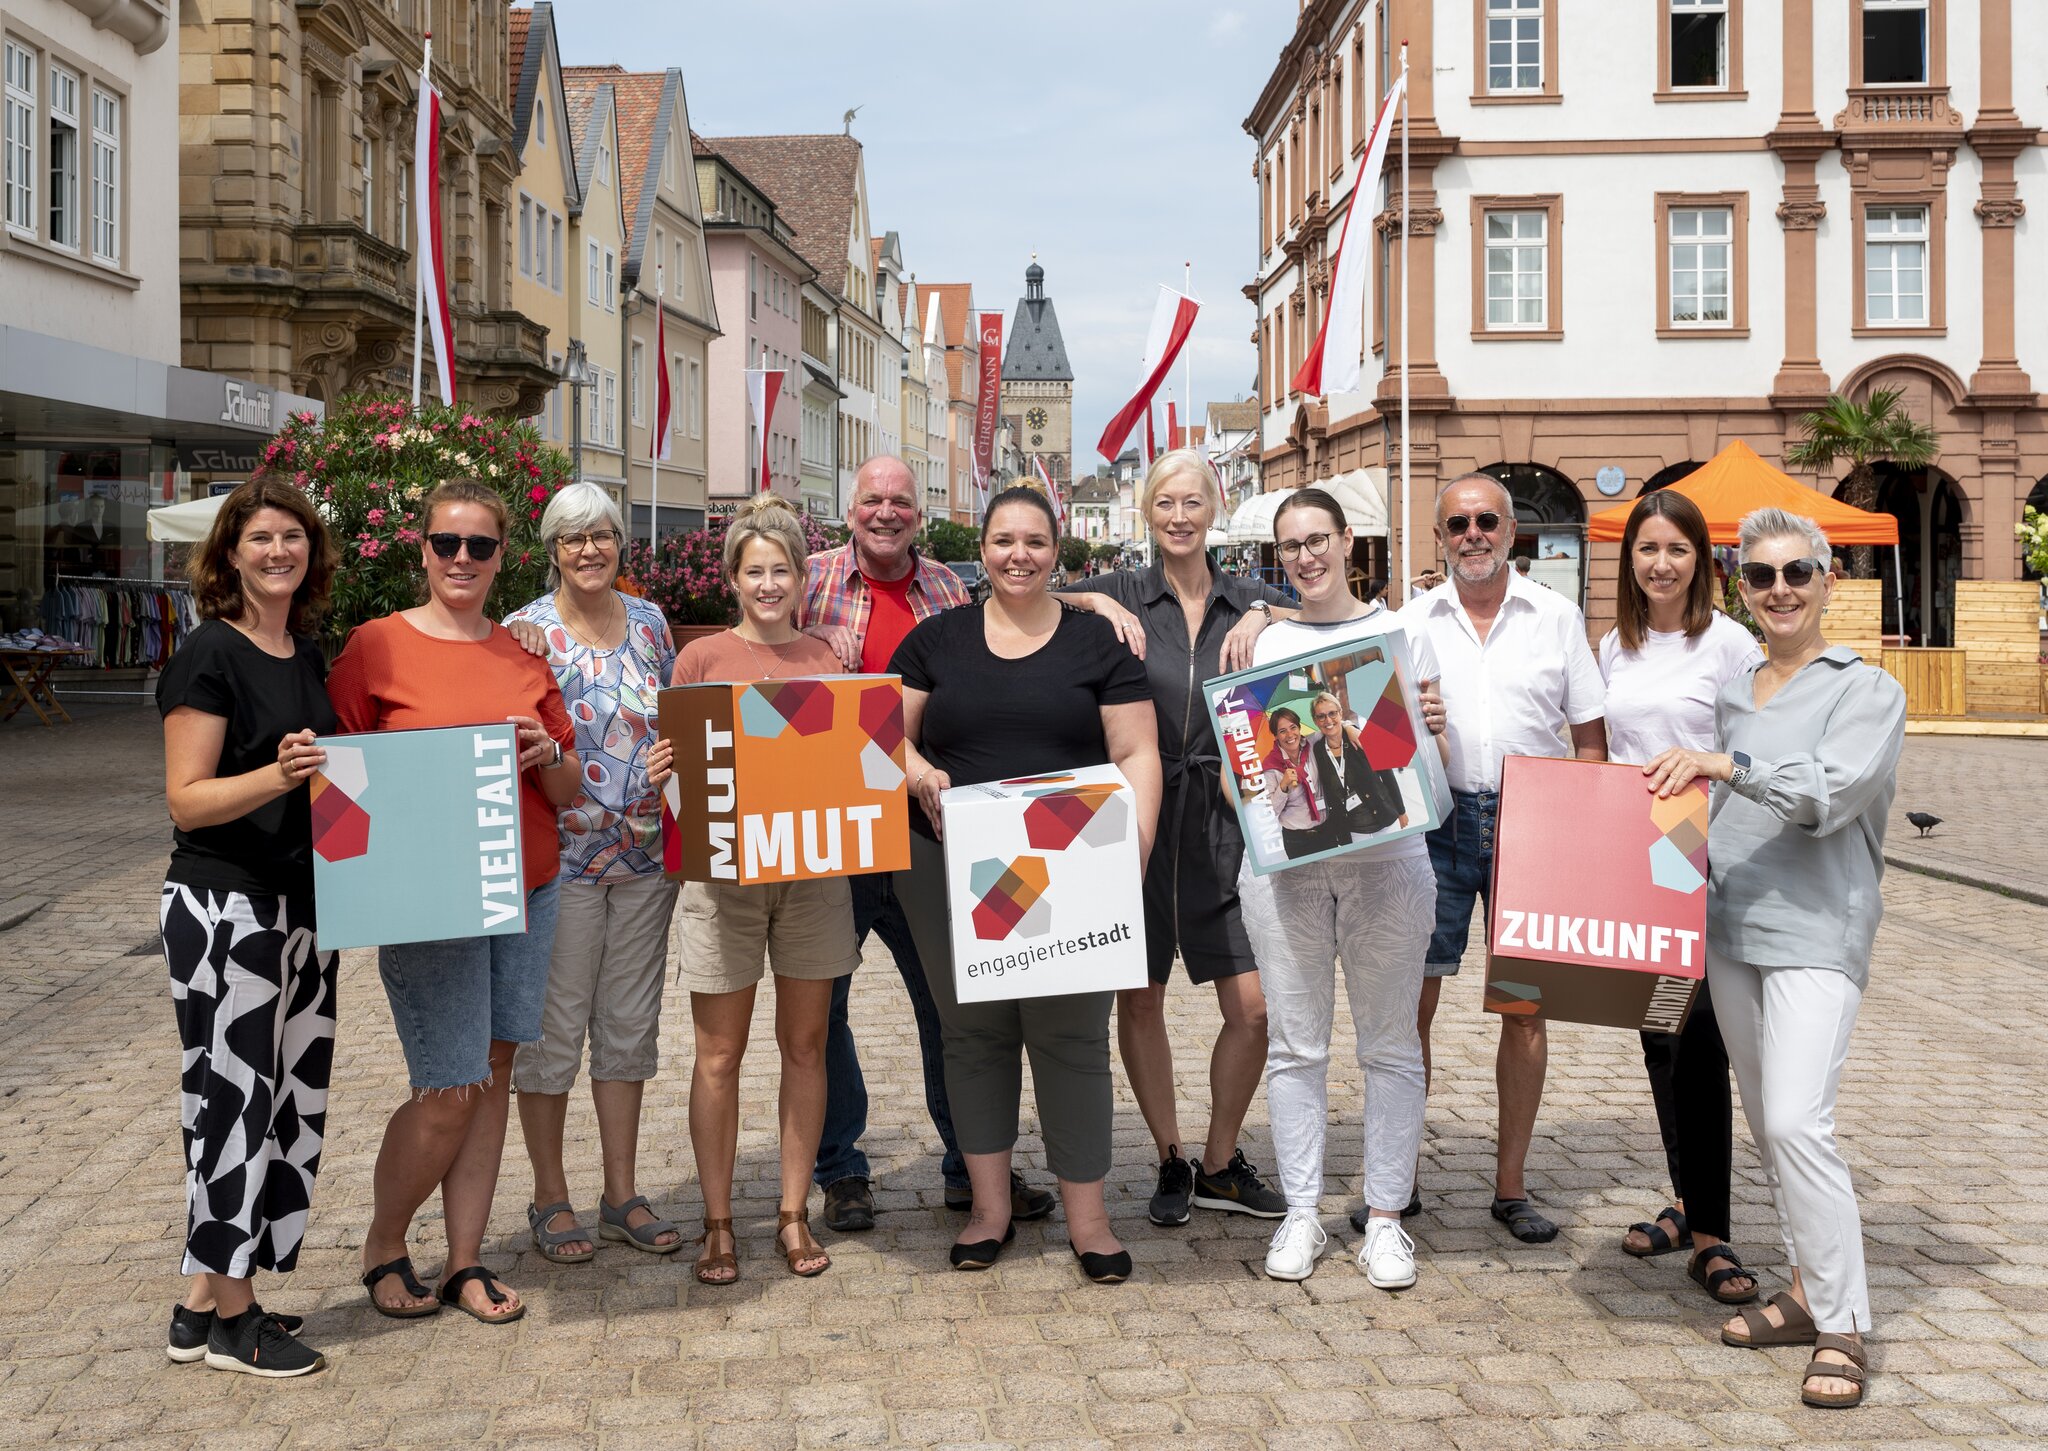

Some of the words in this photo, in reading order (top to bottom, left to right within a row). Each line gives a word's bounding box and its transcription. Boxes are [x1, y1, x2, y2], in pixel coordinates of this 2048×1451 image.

[221, 381, 271, 428] Schmitt
[979, 357, 997, 456] CHRISTMANN
[705, 719, 737, 880] MUT
[1223, 698, 1284, 854] ENGAGEMENT
[474, 733, 519, 929] VIELFALT
[743, 804, 882, 879] MUT
[967, 923, 1131, 978] engagiertestadt
[1499, 910, 1700, 967] ZUKUNFT
[1641, 975, 1697, 1033] ZUKUNFT
